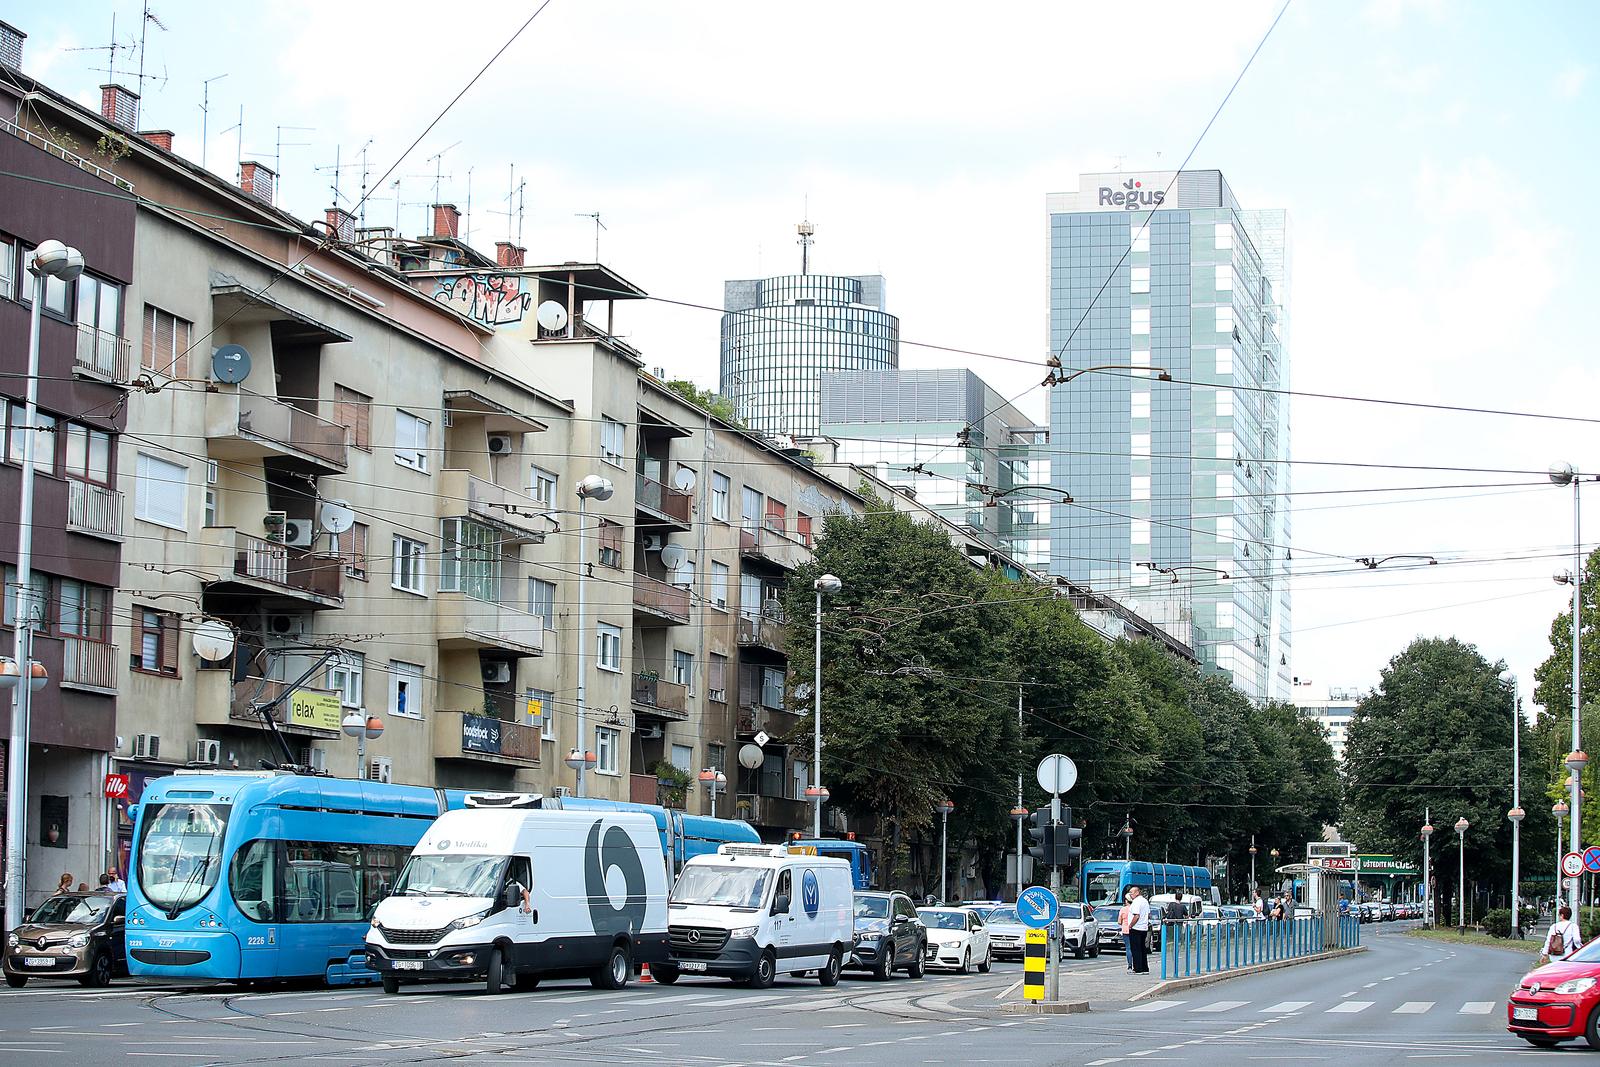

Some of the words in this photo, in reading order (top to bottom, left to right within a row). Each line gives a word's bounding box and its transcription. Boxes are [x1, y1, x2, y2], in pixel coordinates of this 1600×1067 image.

[1099, 187, 1165, 210] Regus
[292, 699, 315, 719] relax
[106, 777, 127, 797] illy
[454, 840, 488, 849] Medika
[1323, 859, 1352, 868] SPAR
[774, 920, 782, 931] 117
[248, 936, 265, 945] 2226
